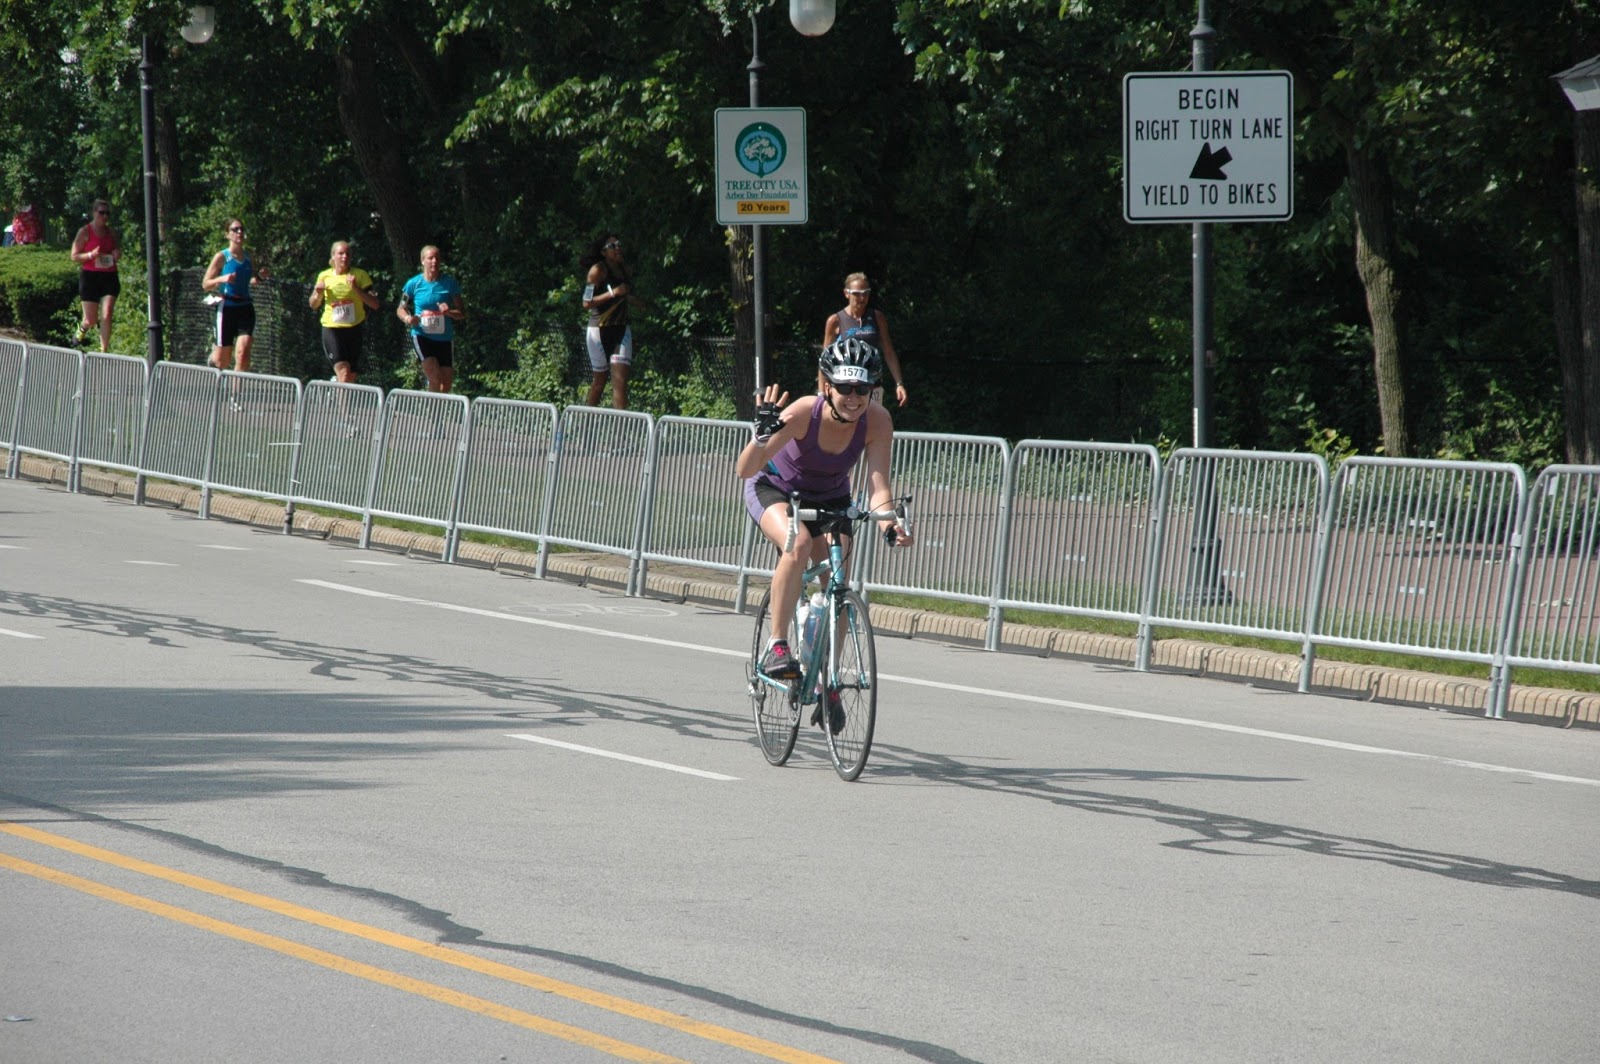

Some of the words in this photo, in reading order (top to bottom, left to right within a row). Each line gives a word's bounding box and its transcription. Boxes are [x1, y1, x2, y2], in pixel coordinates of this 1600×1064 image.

[1178, 88, 1239, 110] BEGIN
[1135, 119, 1179, 141] RIGHT
[1190, 118, 1232, 140] TURN
[1242, 117, 1283, 139] LANE
[725, 180, 752, 190] TREE
[752, 180, 777, 190] CITY
[725, 191, 745, 200] Arbor
[746, 191, 759, 200] Day
[761, 190, 798, 199] Foundation
[1142, 184, 1189, 206] YIELD
[1200, 184, 1218, 205] TO
[1228, 183, 1276, 204] BIKES
[740, 203, 753, 212] 20
[756, 203, 786, 212] Years
[842, 367, 865, 378] 1577
